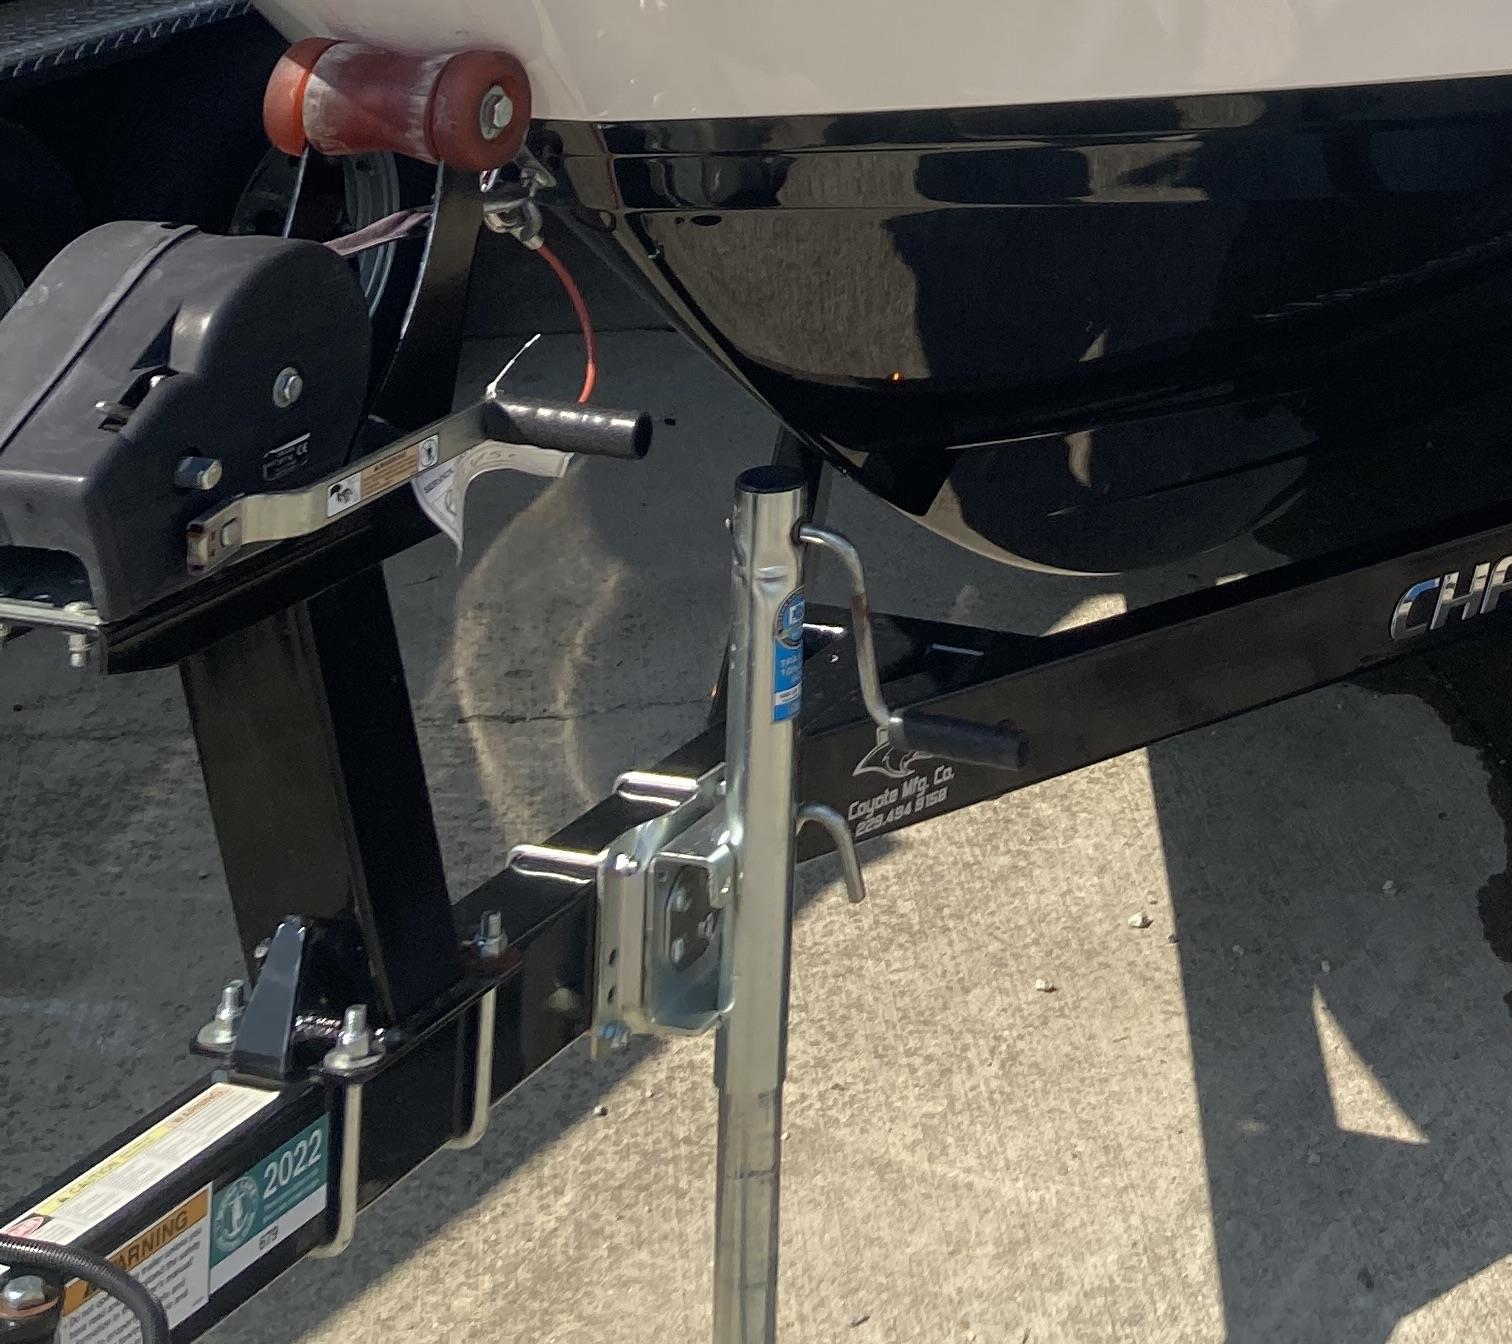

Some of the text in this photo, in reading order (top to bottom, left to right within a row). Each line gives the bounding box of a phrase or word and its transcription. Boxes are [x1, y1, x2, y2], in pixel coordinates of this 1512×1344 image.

[848, 788, 899, 821] Coyote
[263, 1128, 322, 1199] 2022
[116, 1211, 188, 1271] ARNING
